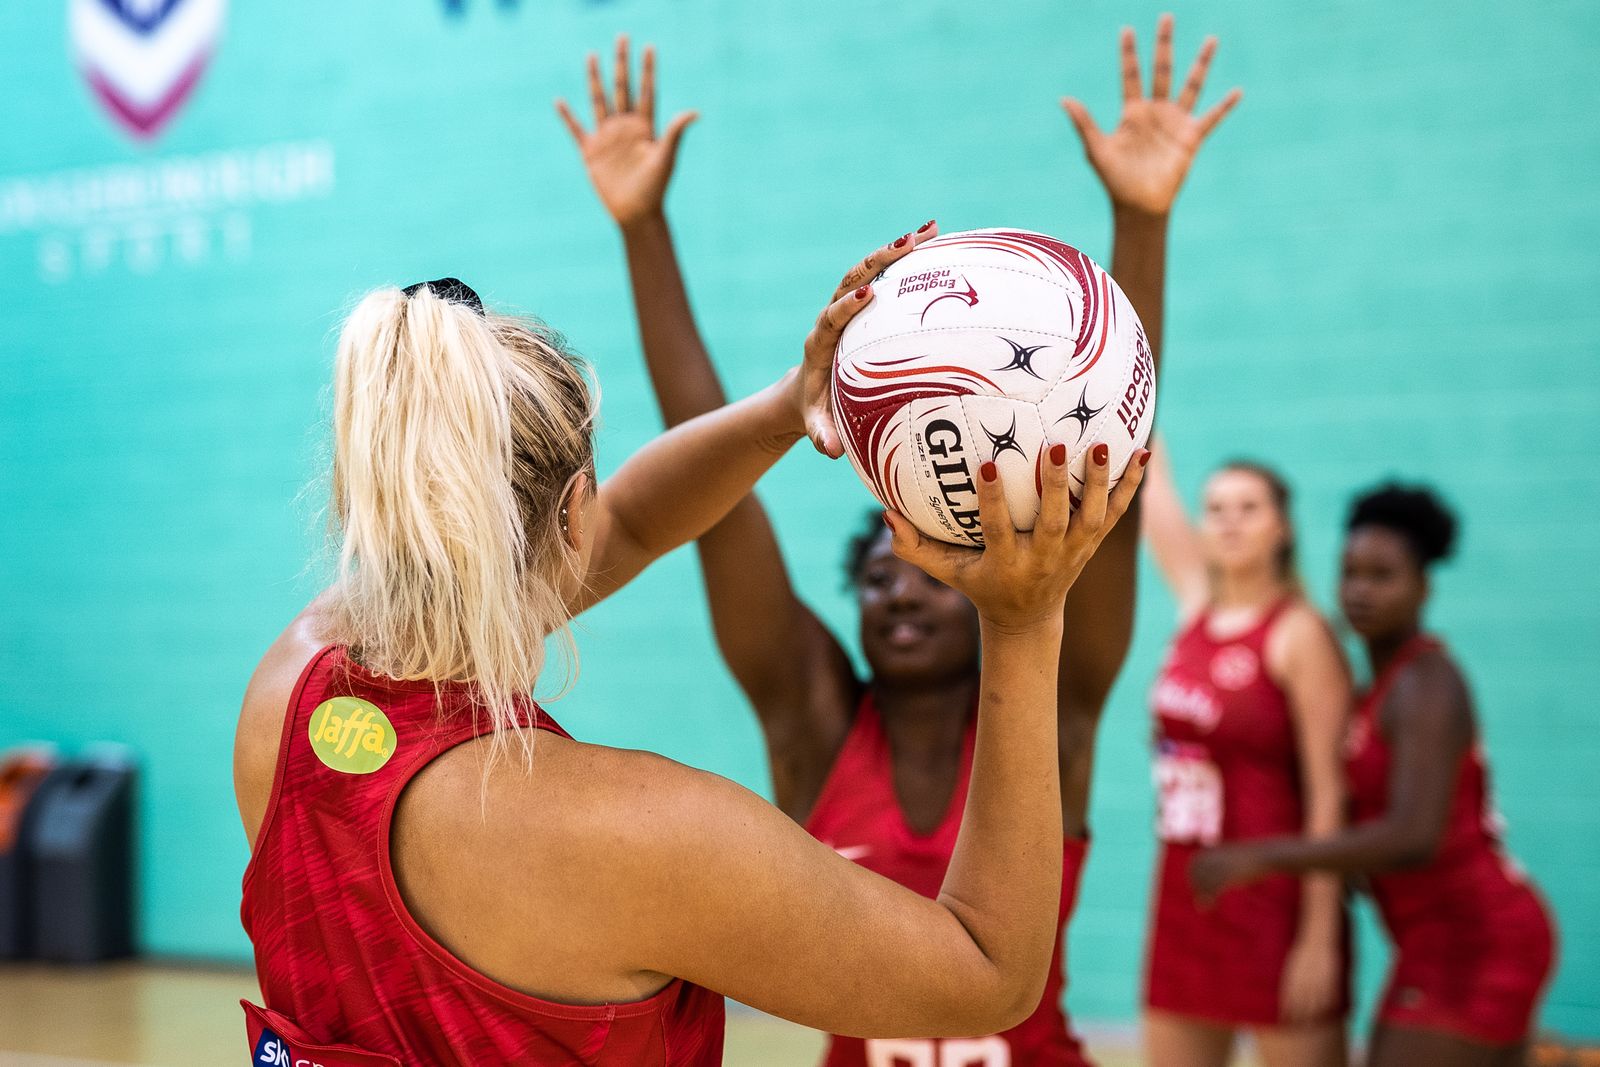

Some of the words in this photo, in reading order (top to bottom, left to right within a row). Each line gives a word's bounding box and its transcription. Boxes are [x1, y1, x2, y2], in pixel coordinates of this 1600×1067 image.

[898, 279, 956, 298] England
[900, 270, 950, 287] netball
[1117, 323, 1146, 425] netball
[314, 702, 386, 758] Jaffa
